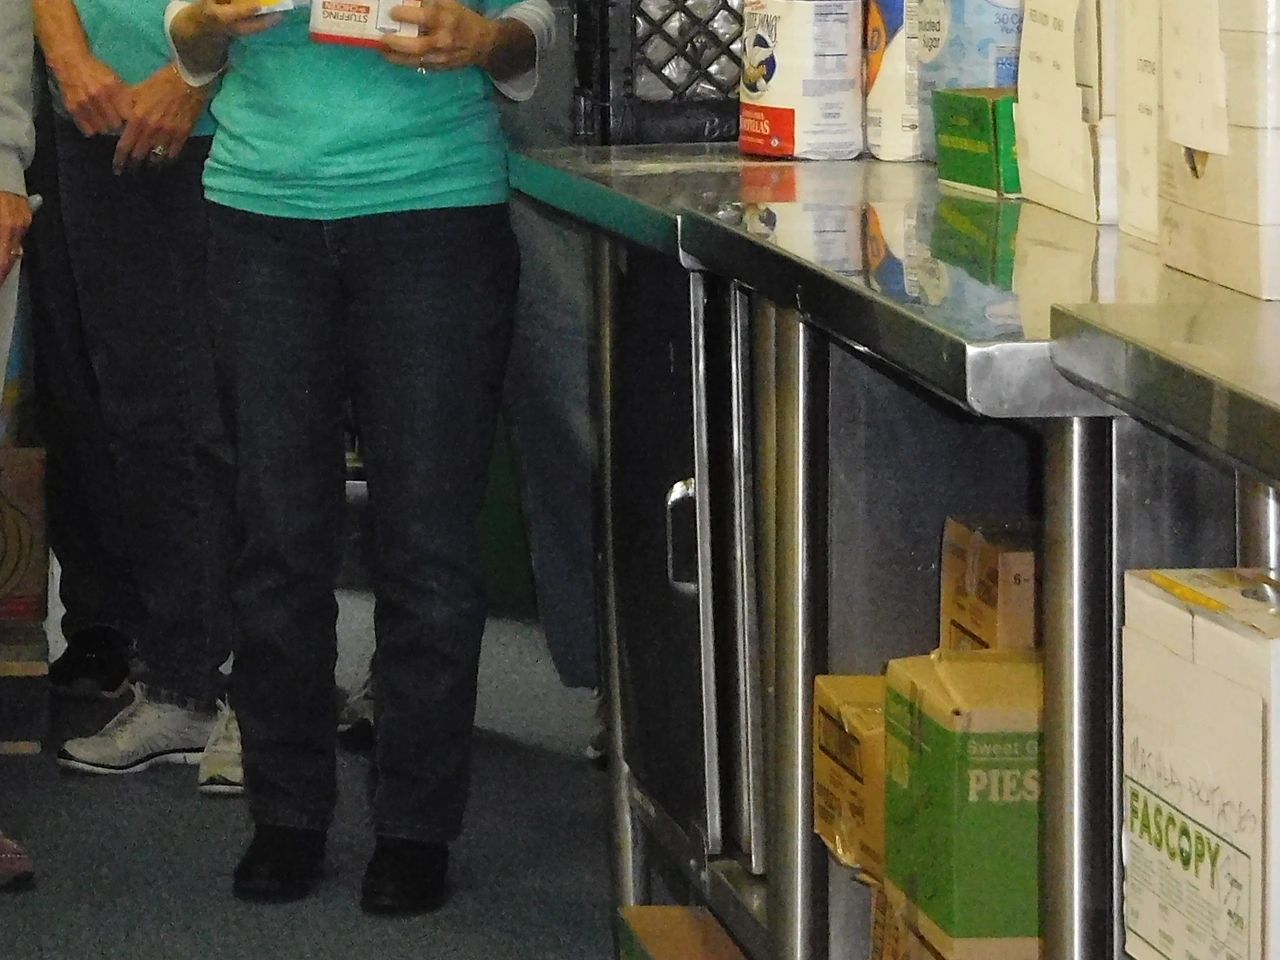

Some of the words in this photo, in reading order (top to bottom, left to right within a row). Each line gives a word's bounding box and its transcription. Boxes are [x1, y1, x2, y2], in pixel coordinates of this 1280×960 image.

[321, 10, 369, 24] STUFFING
[967, 768, 1040, 802] PIES
[1128, 786, 1220, 890] FASCOPY
